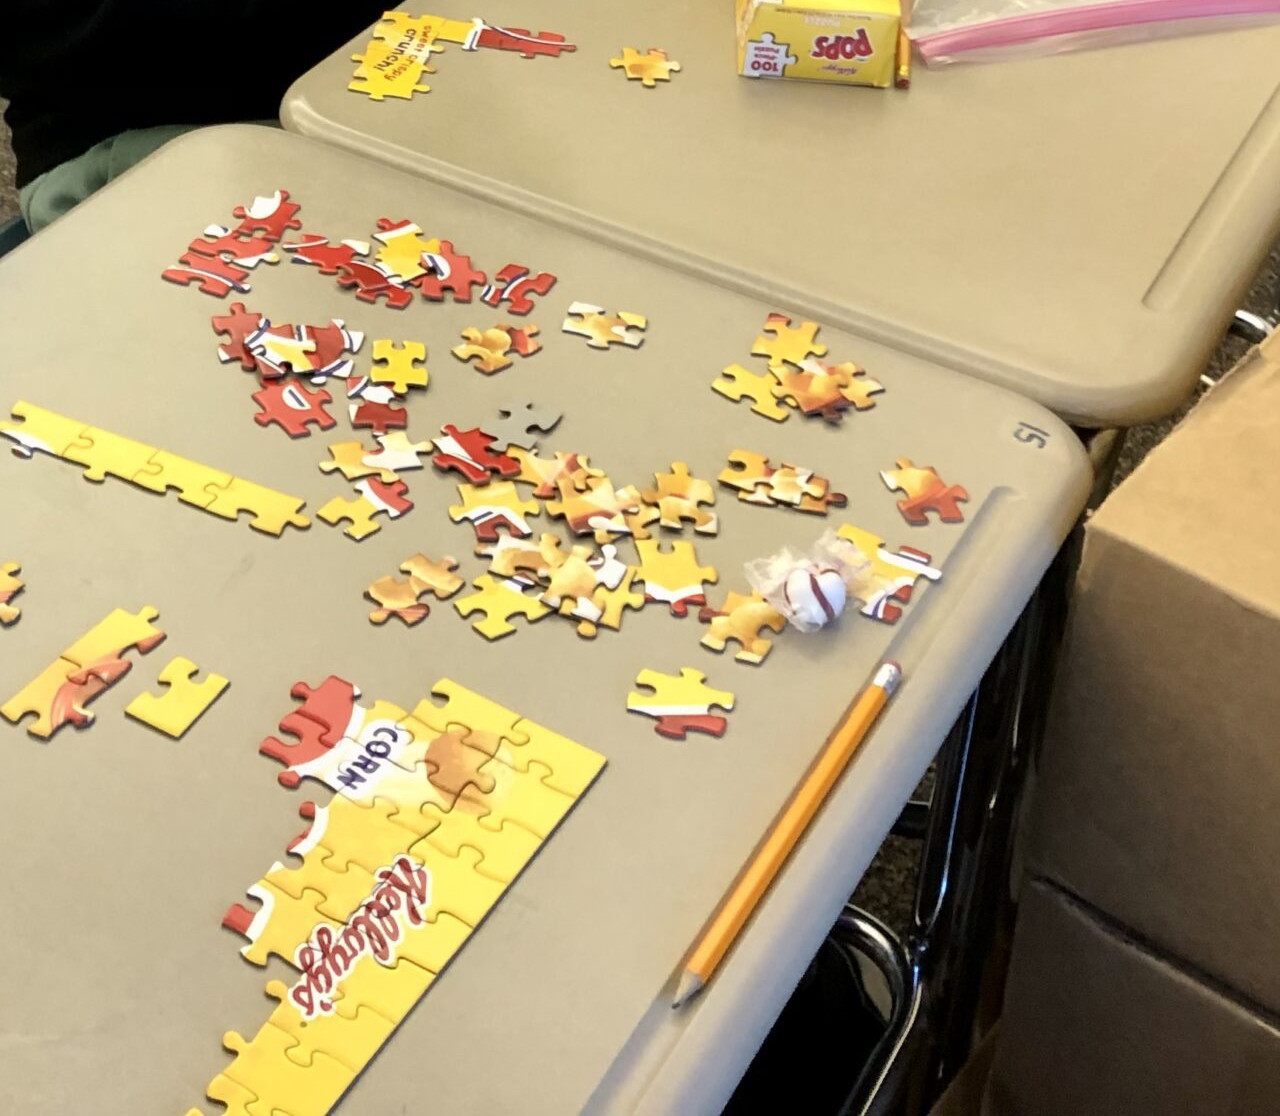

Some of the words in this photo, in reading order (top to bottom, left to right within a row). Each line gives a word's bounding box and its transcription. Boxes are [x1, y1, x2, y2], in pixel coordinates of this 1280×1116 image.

[811, 27, 874, 61] POPS
[383, 54, 418, 81] crispy
[751, 60, 780, 72] 100
[337, 726, 399, 790] CORN
[292, 857, 430, 1019] Kellogg's
